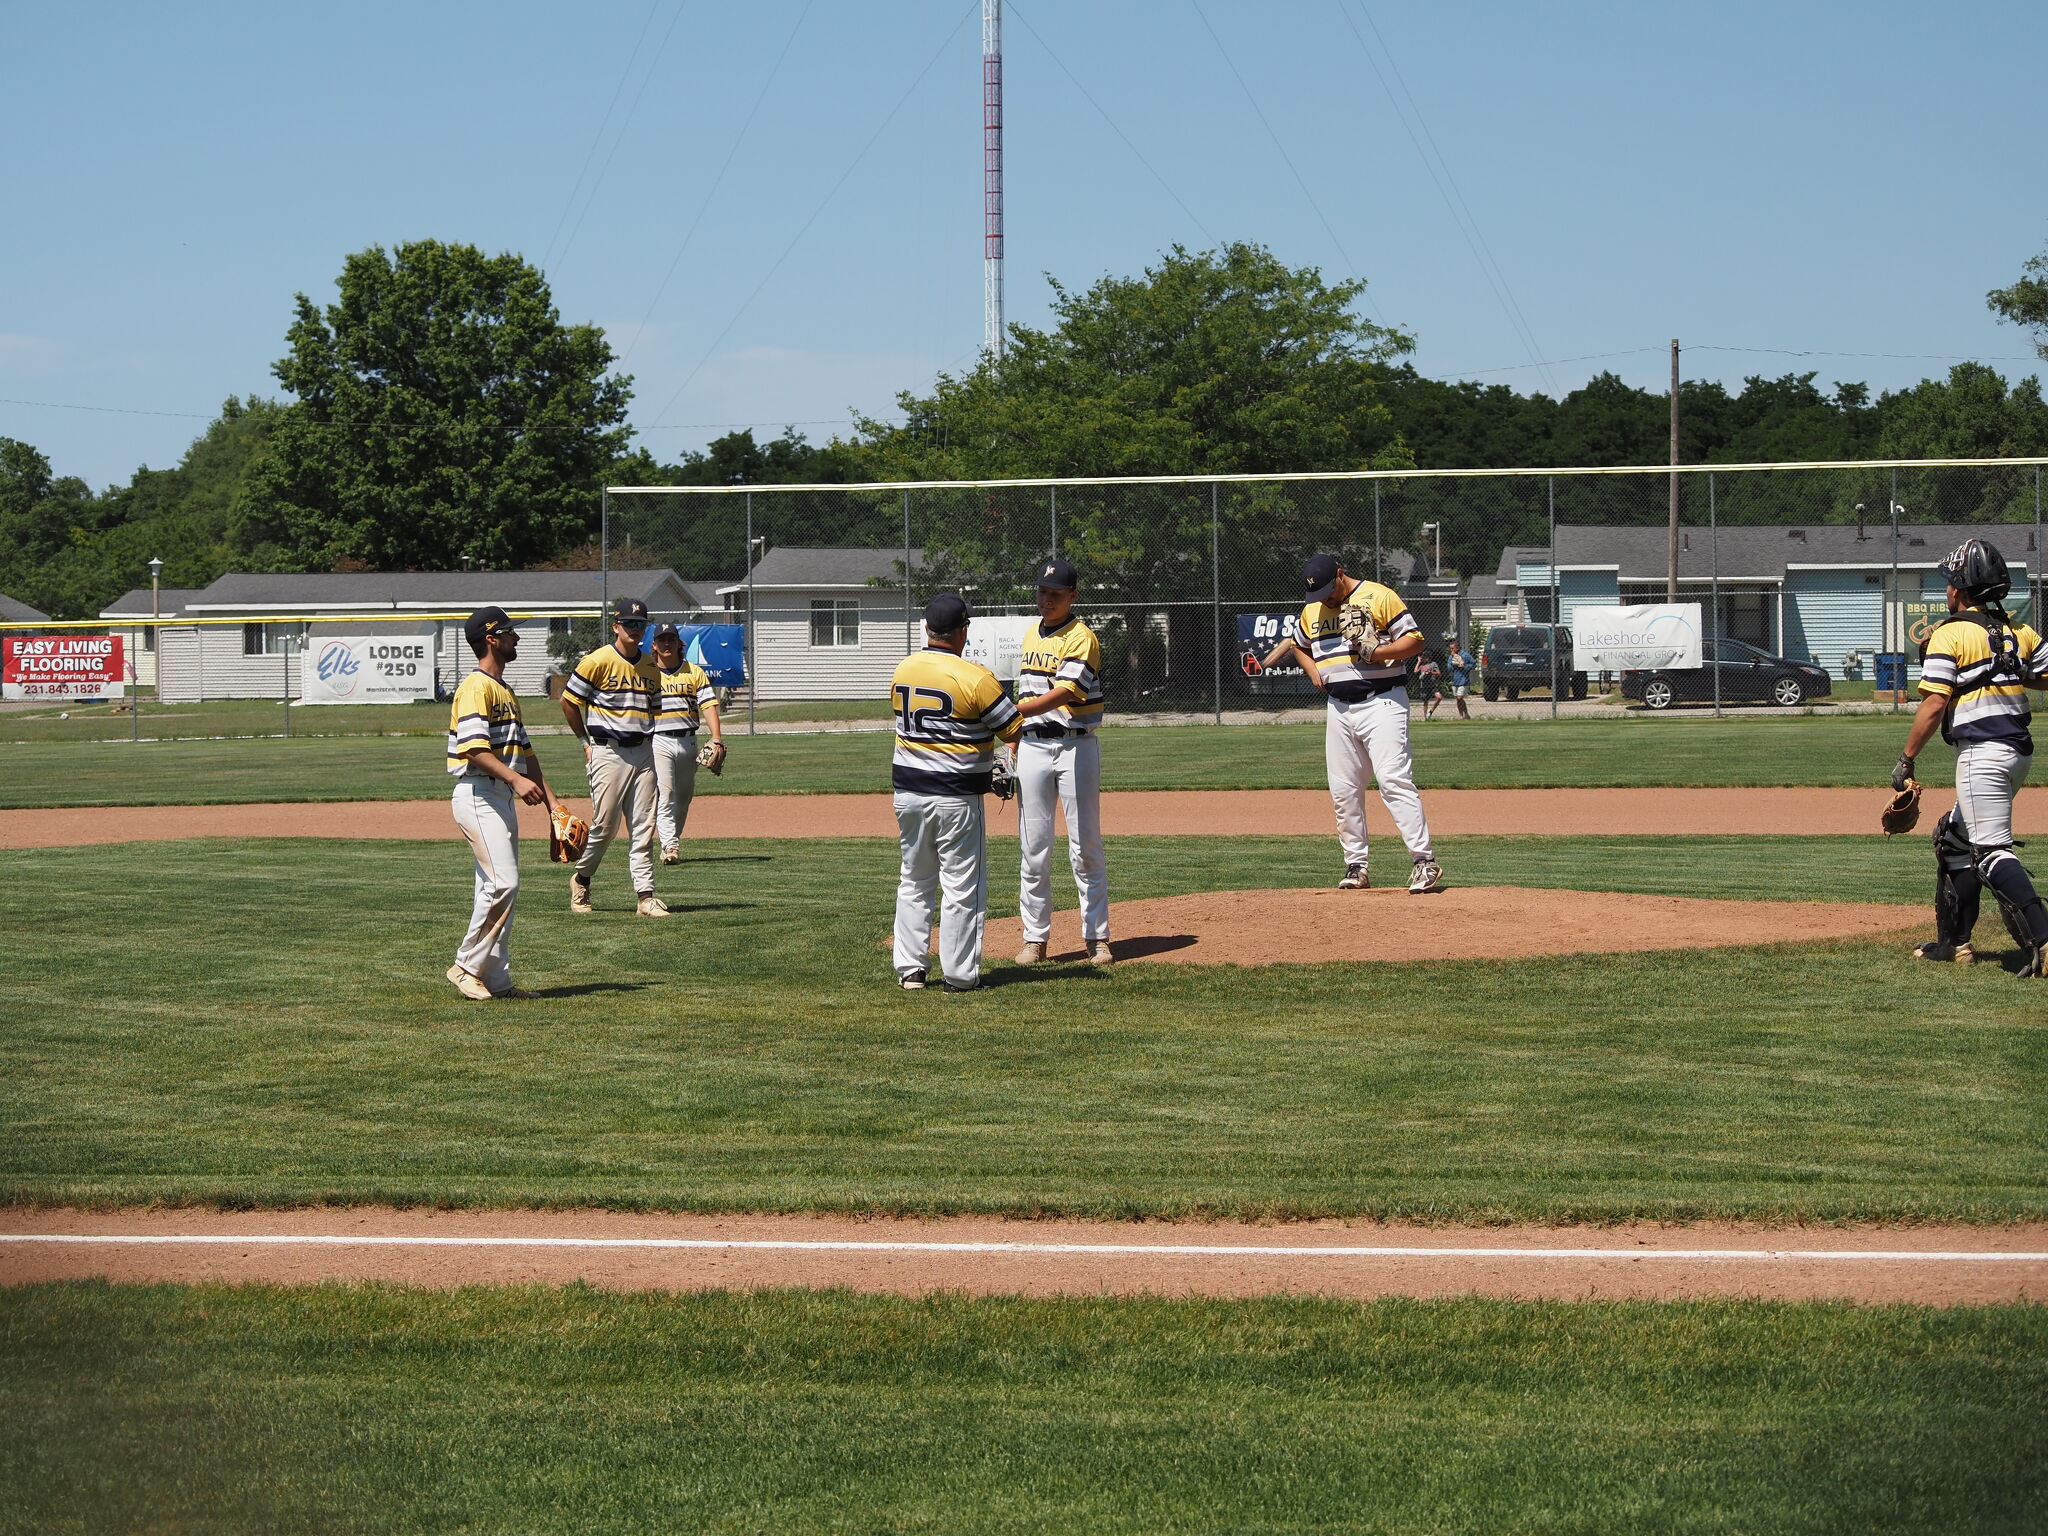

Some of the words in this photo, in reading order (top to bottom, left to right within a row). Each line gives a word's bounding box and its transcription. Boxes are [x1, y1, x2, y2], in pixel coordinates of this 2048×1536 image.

[1907, 603, 1927, 613] BBQ
[1254, 616, 1278, 637] Go
[1579, 631, 1656, 646] Lakeshore
[13, 641, 55, 655] EASY
[59, 640, 112, 655] LIVING
[369, 645, 424, 659] LODGE
[20, 658, 103, 671] FLOORING
[317, 646, 361, 681] Elks
[1021, 652, 1059, 670] AINTS
[377, 662, 417, 676] #250
[704, 670, 722, 678] ANK
[53, 673, 86, 681] Flooring
[24, 684, 101, 694] 231.843.1826
[660, 684, 694, 694] AINTS
[895, 684, 954, 734] 12
